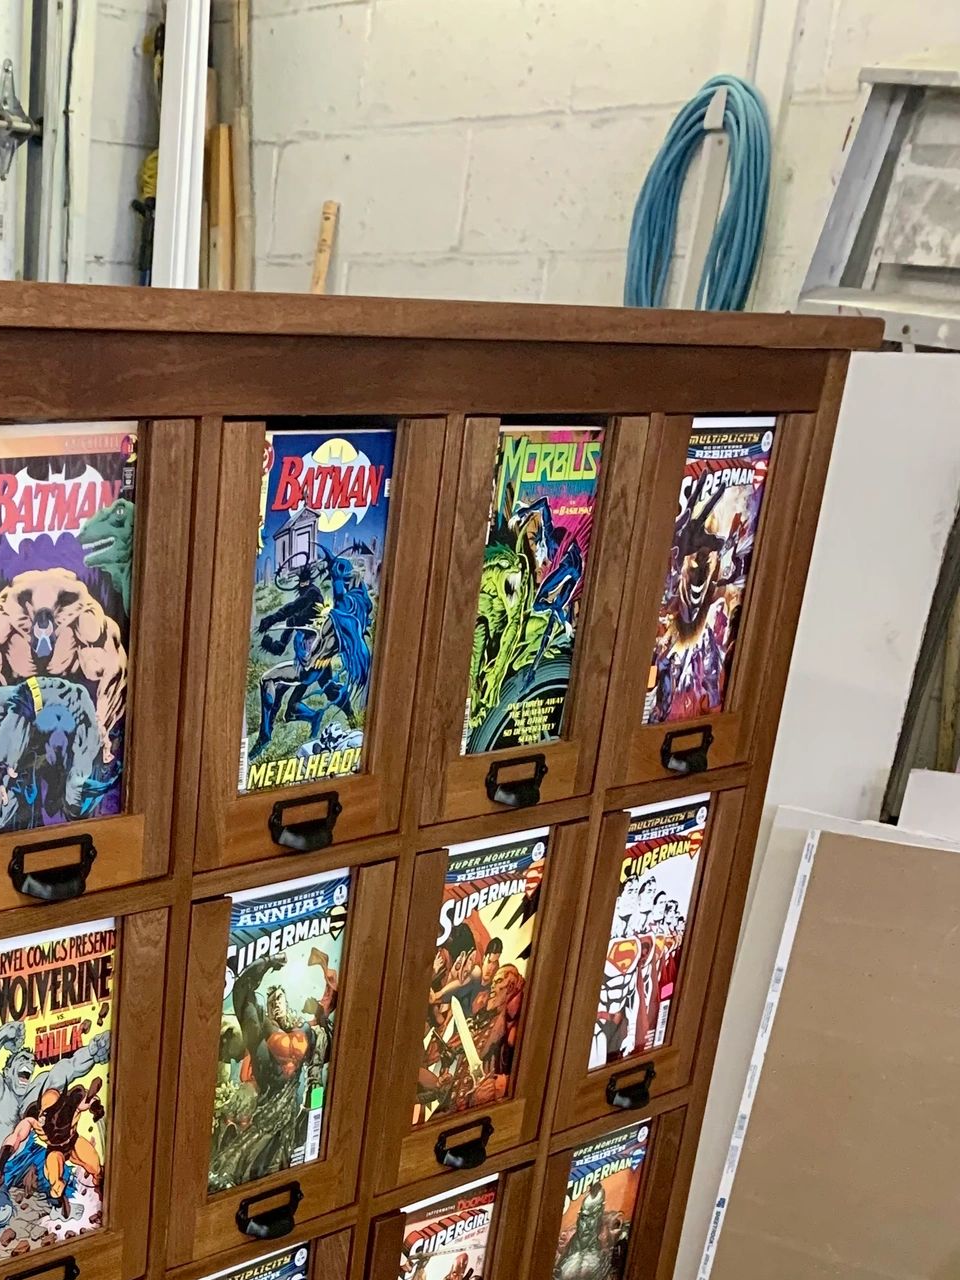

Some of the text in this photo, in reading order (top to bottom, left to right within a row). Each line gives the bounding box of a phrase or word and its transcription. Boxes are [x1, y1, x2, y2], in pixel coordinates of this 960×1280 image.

[689, 432, 760, 445] MULTIPLICITY
[695, 447, 750, 459] REBIRTH
[271, 456, 385, 512] BATMAN
[497, 435, 601, 513] MORBIUS
[247, 748, 361, 790] METALHEAD!
[628, 812, 687, 832] MULTIPLICITY
[634, 824, 685, 842] REBIRTH
[449, 856, 482, 871] SUPER
[482, 847, 528, 864] MONSTER
[455, 862, 519, 882] REBIRTH
[236, 896, 328, 926] ANNUAL
[436, 879, 527, 947] SUPERMAN
[26, 939, 68, 968] COMICS
[34, 1025, 84, 1063] HULK
[594, 1134, 628, 1150] MONSTER
